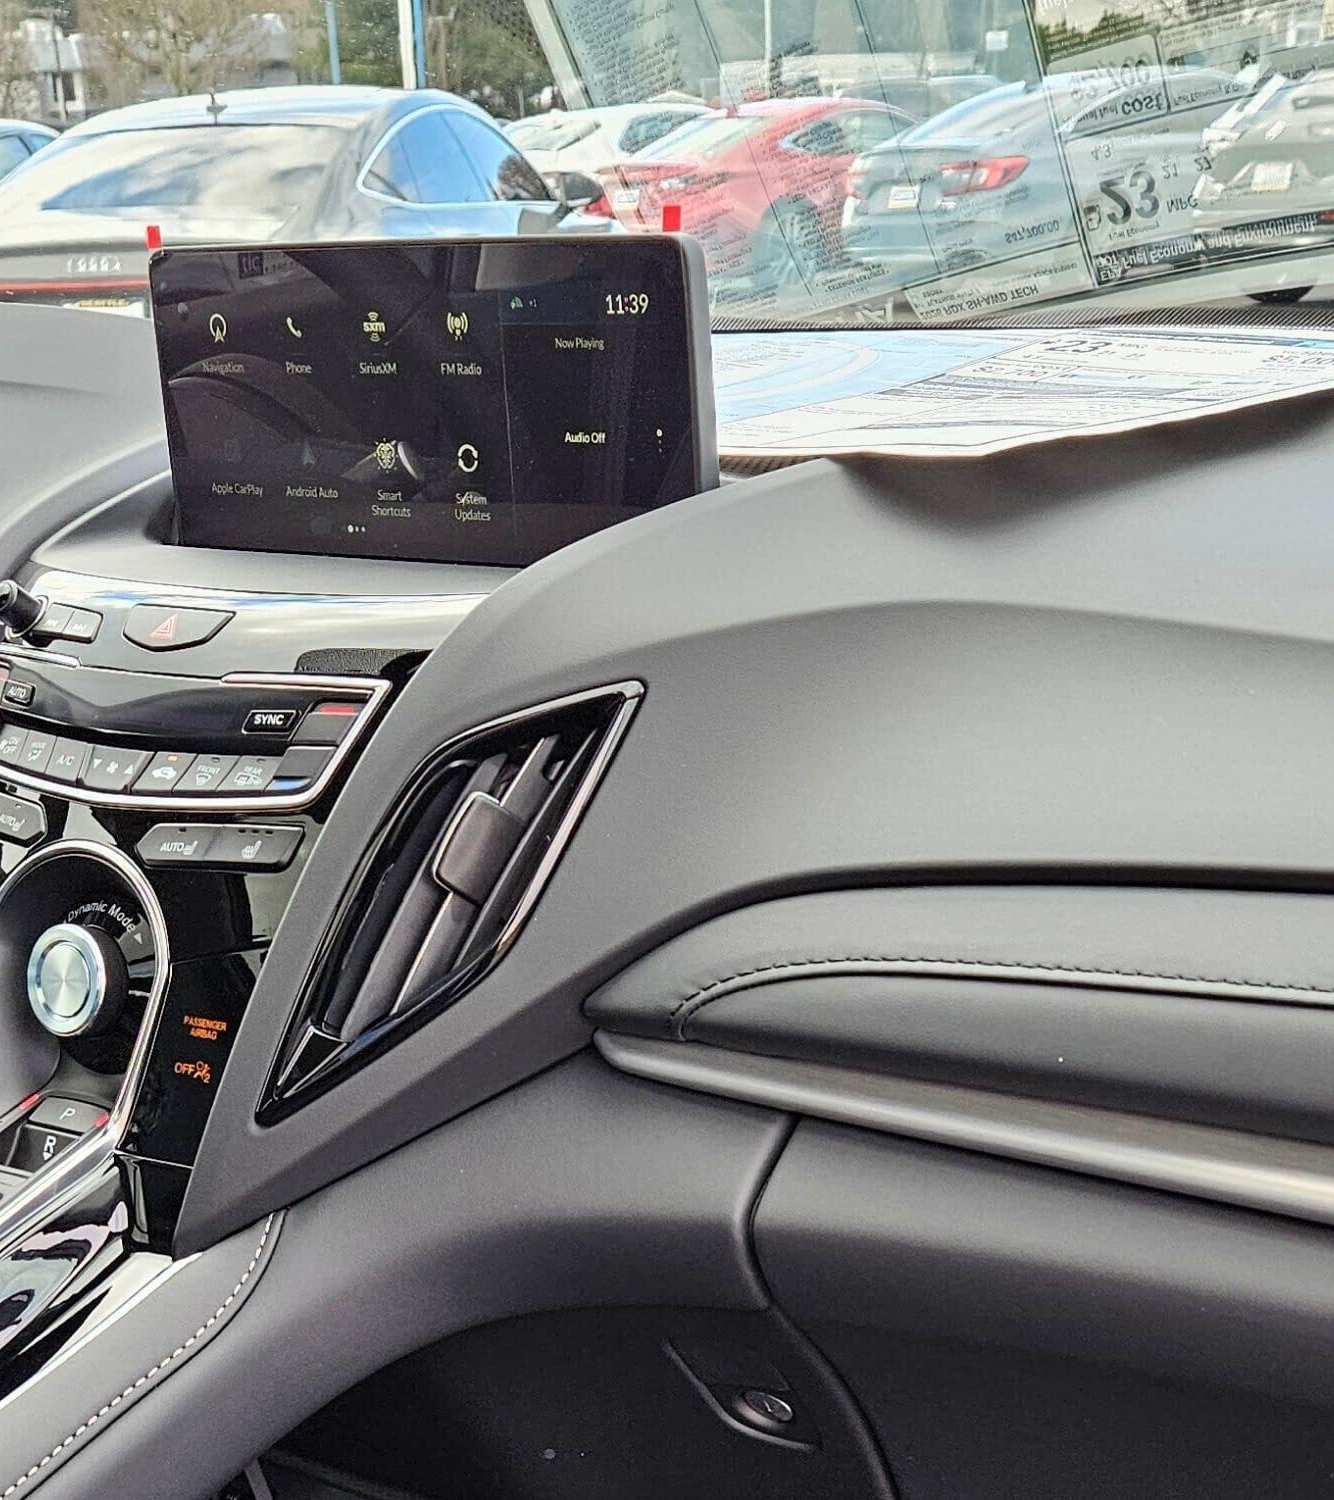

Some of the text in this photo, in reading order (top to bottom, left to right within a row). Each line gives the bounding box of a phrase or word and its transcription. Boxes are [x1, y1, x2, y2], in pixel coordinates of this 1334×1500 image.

[605, 294, 649, 315] 11:39
[555, 338, 604, 351] Now Playing
[203, 362, 245, 375] Navigation
[285, 361, 312, 374] Phone
[359, 362, 397, 375] SiriusXM
[441, 363, 482, 376] FM Radio
[565, 432, 606, 445] Audio Off
[211, 482, 263, 498] Apple CarPlay
[286, 486, 339, 499] Android Auto
[377, 490, 402, 502] Smart
[455, 492, 487, 507] System
[371, 504, 411, 518] Shortcuts
[455, 508, 491, 522] Updates
[8, 685, 26, 697] AUTO
[253, 715, 285, 725] SYNC
[56, 755, 75, 766] A/C
[197, 765, 220, 775] FRONT
[245, 766, 262, 774] REAR
[160, 842, 184, 852] AUTO
[68, 902, 136, 933] Dynamic Mode
[183, 1015, 227, 1031] PASSENGER
[190, 1028, 217, 1040] AIRBAG
[174, 1062, 195, 1075] OFF
[59, 1107, 76, 1120] P
[43, 1135, 56, 1153] R
